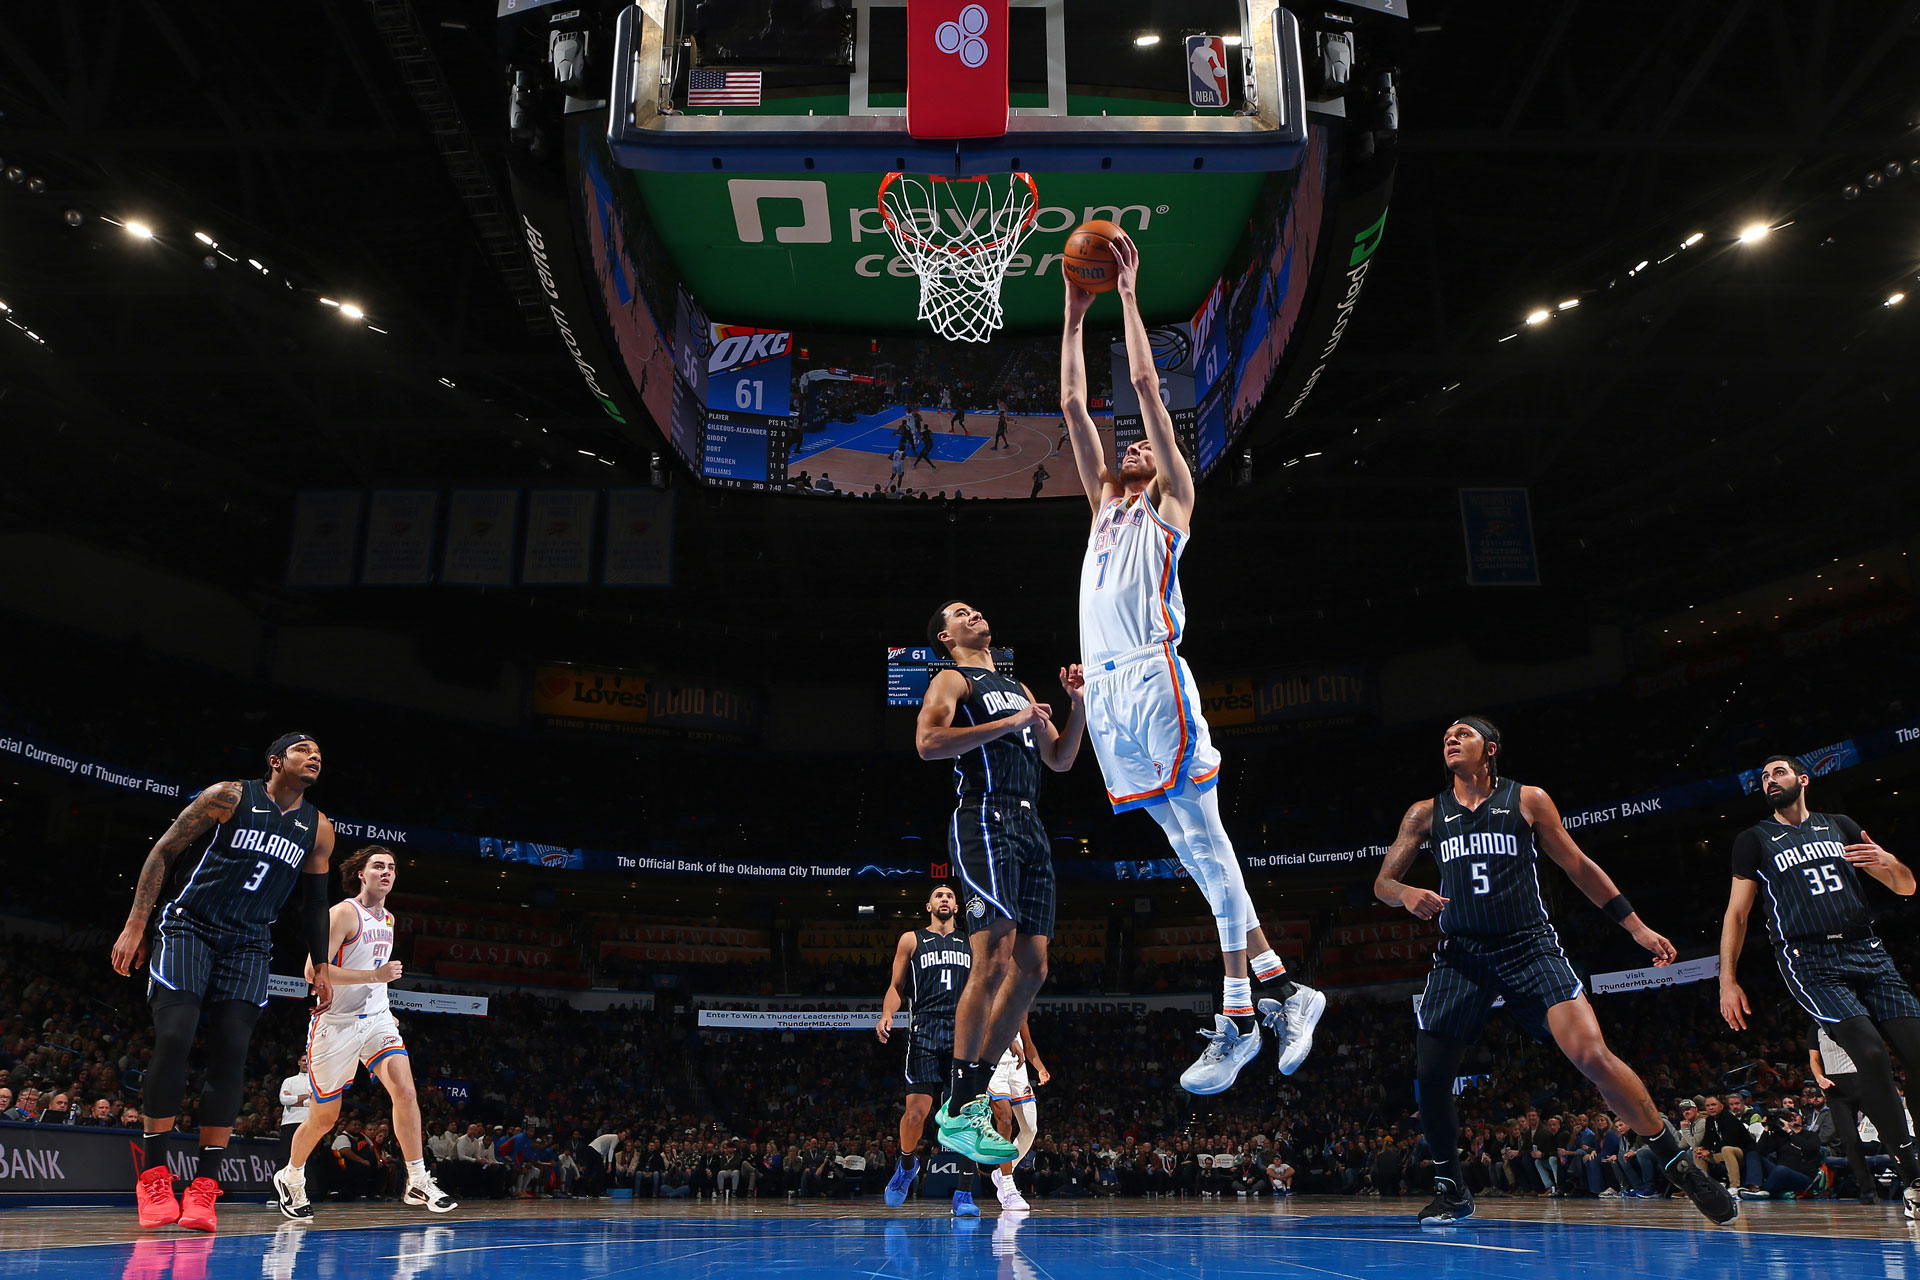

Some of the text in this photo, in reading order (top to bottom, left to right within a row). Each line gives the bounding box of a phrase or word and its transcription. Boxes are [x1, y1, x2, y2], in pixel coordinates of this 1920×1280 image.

[1195, 89, 1215, 104] NBA
[523, 215, 559, 300] center
[854, 253, 1065, 278] ceer
[1320, 259, 1370, 360] paycom
[550, 304, 609, 398] paycom
[708, 332, 790, 373] OKC
[684, 344, 698, 389] 56
[1206, 344, 1217, 386] 61
[735, 379, 763, 410] 61
[708, 412, 729, 421] PLAYER
[1116, 418, 1137, 426] PLAYER
[706, 434, 728, 442] GIDDEY
[707, 423, 768, 436] GILGEOUS-ALEXANDER
[704, 466, 732, 476] WILLIAMS
[705, 456, 736, 465] HOLMGREN
[752, 482, 764, 490] 3RD
[1096, 549, 1112, 591] 7
[911, 650, 926, 660] 61
[654, 687, 755, 725] LOUD CITY
[983, 690, 1031, 715] ORLAN
[1201, 693, 1252, 712] ves
[1259, 675, 1364, 716] LOUD CITY
[1895, 727, 1920, 744] The
[25, 743, 79, 774] Currency
[80, 763, 95, 777] of
[95, 765, 143, 789] Thunder
[145, 779, 180, 797] Fans!
[1621, 798, 1663, 817] BANK
[328, 818, 363, 837] IRST
[366, 825, 407, 843] BANK
[230, 828, 305, 869] ORLANDO
[1248, 856, 1266, 867] The
[1269, 851, 1306, 866] Official
[1308, 847, 1354, 863] Currency
[1356, 846, 1367, 859] of
[1440, 832, 1518, 863] ORLANDO
[242, 860, 271, 892] 3
[617, 856, 851, 878] The Official Bank of the Oklahoma City Thunder
[1470, 861, 1491, 895] 5
[1802, 863, 1844, 896] 35
[400, 915, 564, 948] RIVERWIND
[618, 927, 748, 946] RIVERWIND
[449, 943, 551, 968] CASINO
[645, 949, 728, 963] CASINO
[920, 950, 972, 969] ORLANDO
[269, 978, 288, 986] More
[940, 968, 952, 991] 4
[1598, 976, 1673, 991] ThunderMBA.com
[706, 1011, 729, 1019] Enter
[803, 1013, 849, 1021] Leadership
[0, 1144, 65, 1180] BANK
[166, 1150, 247, 1183] MIIRST
[931, 1162, 960, 1174] KI
